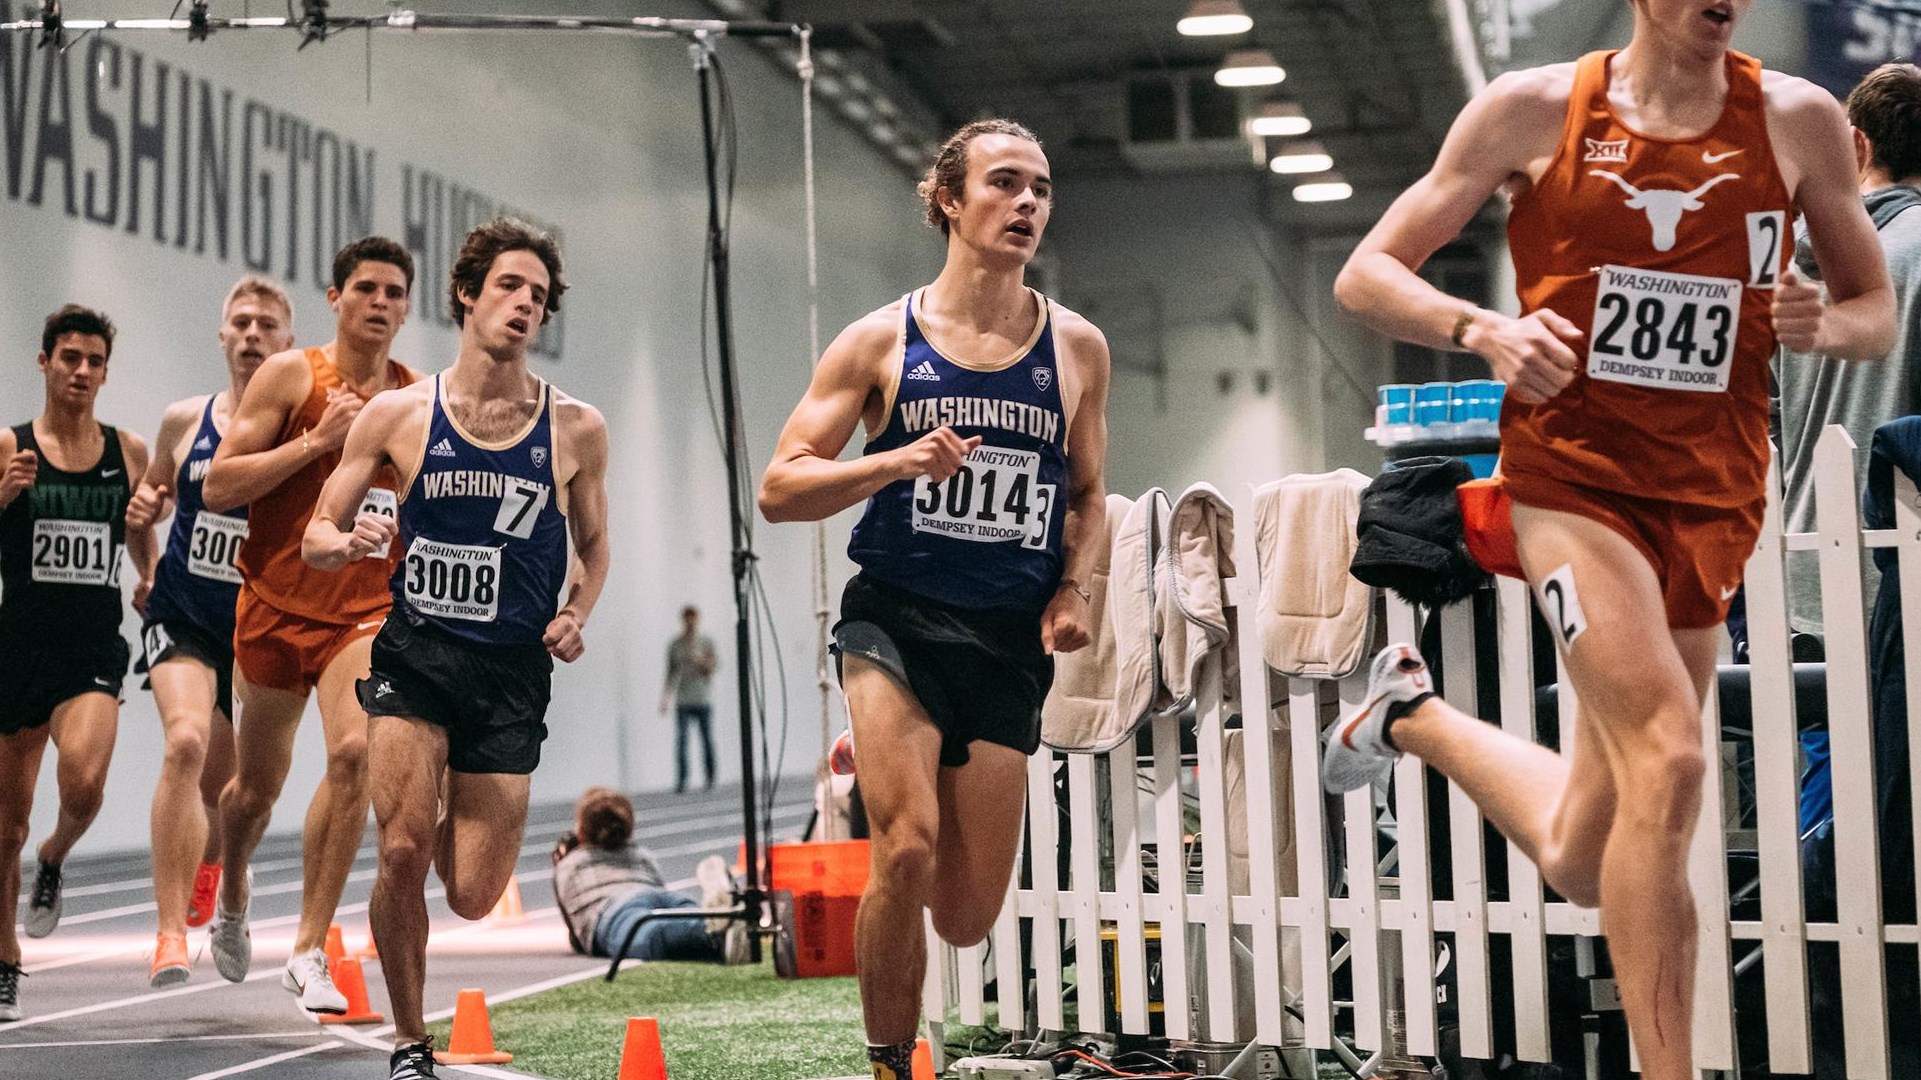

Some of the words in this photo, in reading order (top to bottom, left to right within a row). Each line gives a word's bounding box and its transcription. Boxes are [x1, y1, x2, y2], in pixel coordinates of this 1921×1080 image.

[1755, 215, 1778, 286] 2
[1608, 271, 1732, 300] WASHINGTON
[1593, 292, 1732, 368] 2843
[907, 371, 941, 382] adidas
[1599, 360, 1665, 380] DEMPSEY
[1668, 369, 1718, 386] INDOOR
[900, 396, 1059, 443] WASHINGTON
[429, 448, 456, 457] adidas
[505, 485, 539, 532] 7
[915, 465, 1031, 525] 3014
[921, 517, 976, 534] DEMPSEY
[1030, 487, 1051, 546] 3
[33, 534, 105, 571] 2901
[413, 541, 493, 561] WASHINGTON
[407, 554, 496, 606] 3008
[411, 597, 451, 613] DEMPSEY
[453, 605, 489, 617] INDOOR
[1544, 578, 1577, 643] 2
